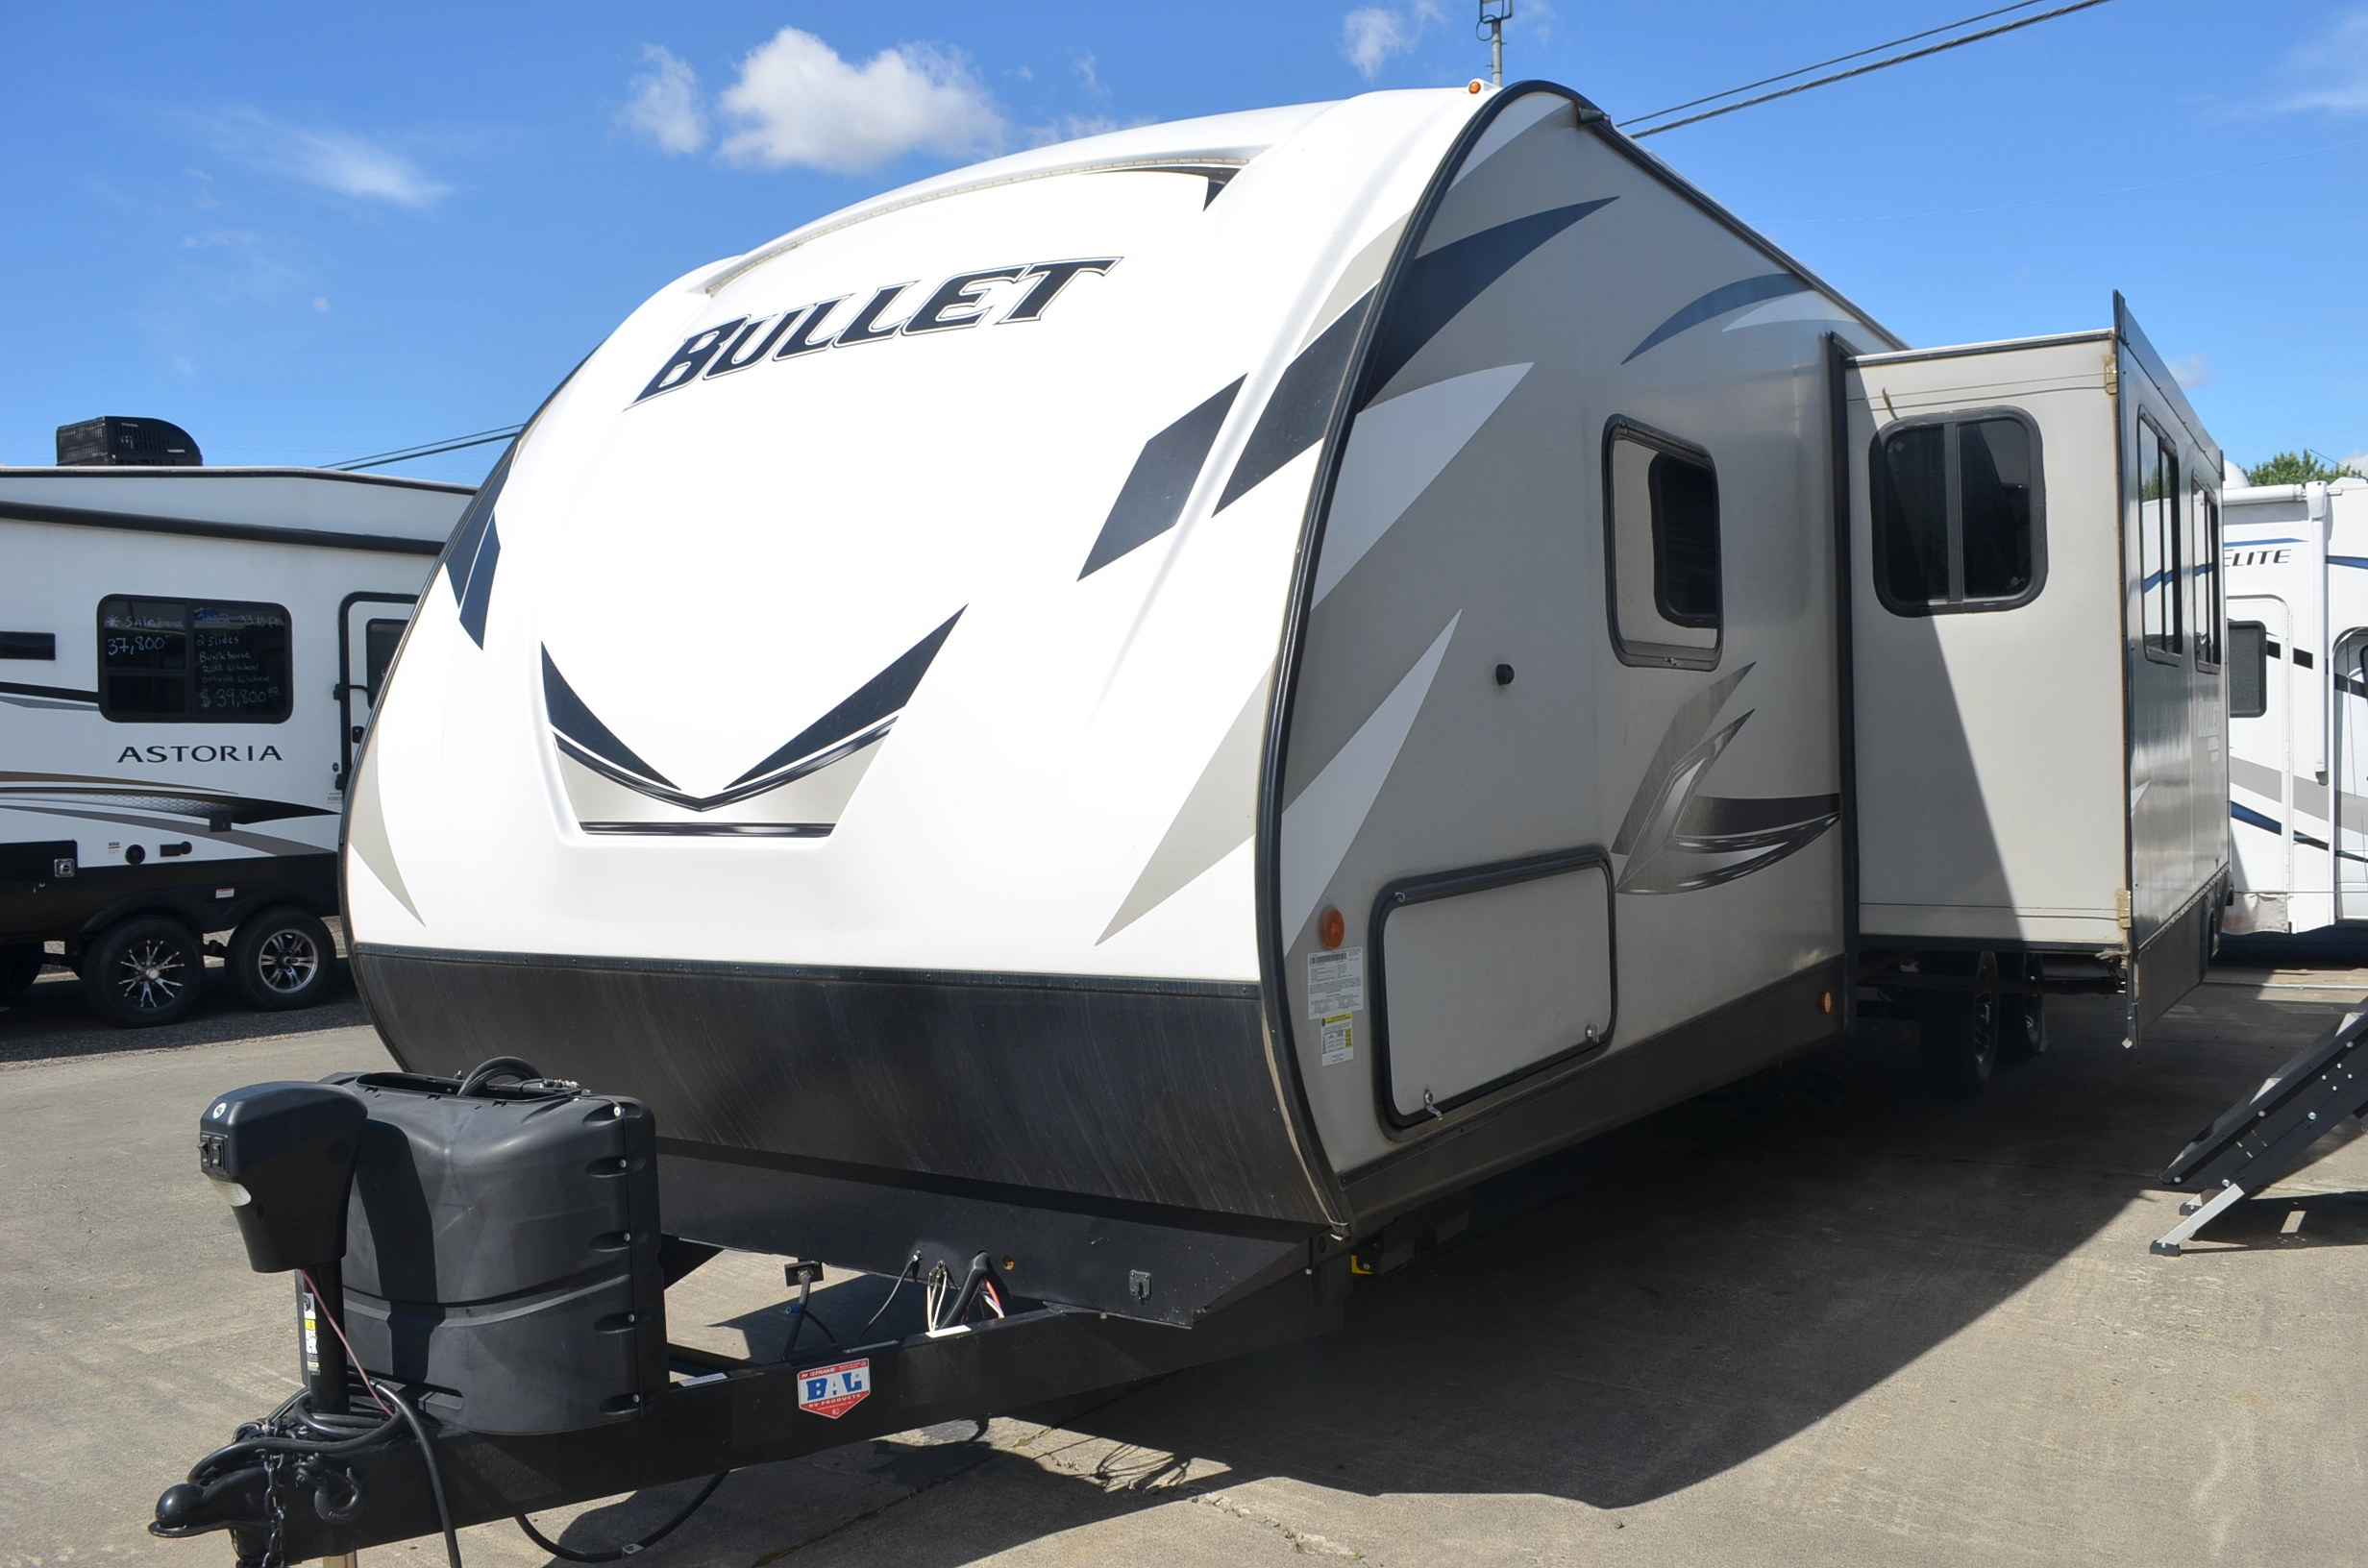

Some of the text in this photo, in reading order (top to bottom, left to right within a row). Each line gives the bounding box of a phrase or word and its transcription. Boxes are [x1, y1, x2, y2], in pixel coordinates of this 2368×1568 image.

[623, 256, 1125, 413] BULLET
[2224, 548, 2292, 568] ELITE
[107, 635, 165, 656] 37,800
[196, 634, 205, 647] 2
[199, 688, 211, 708] $
[116, 745, 284, 764] ASTORIA
[805, 1372, 863, 1401] BAL
[821, 1393, 861, 1406] PRODUCTS
